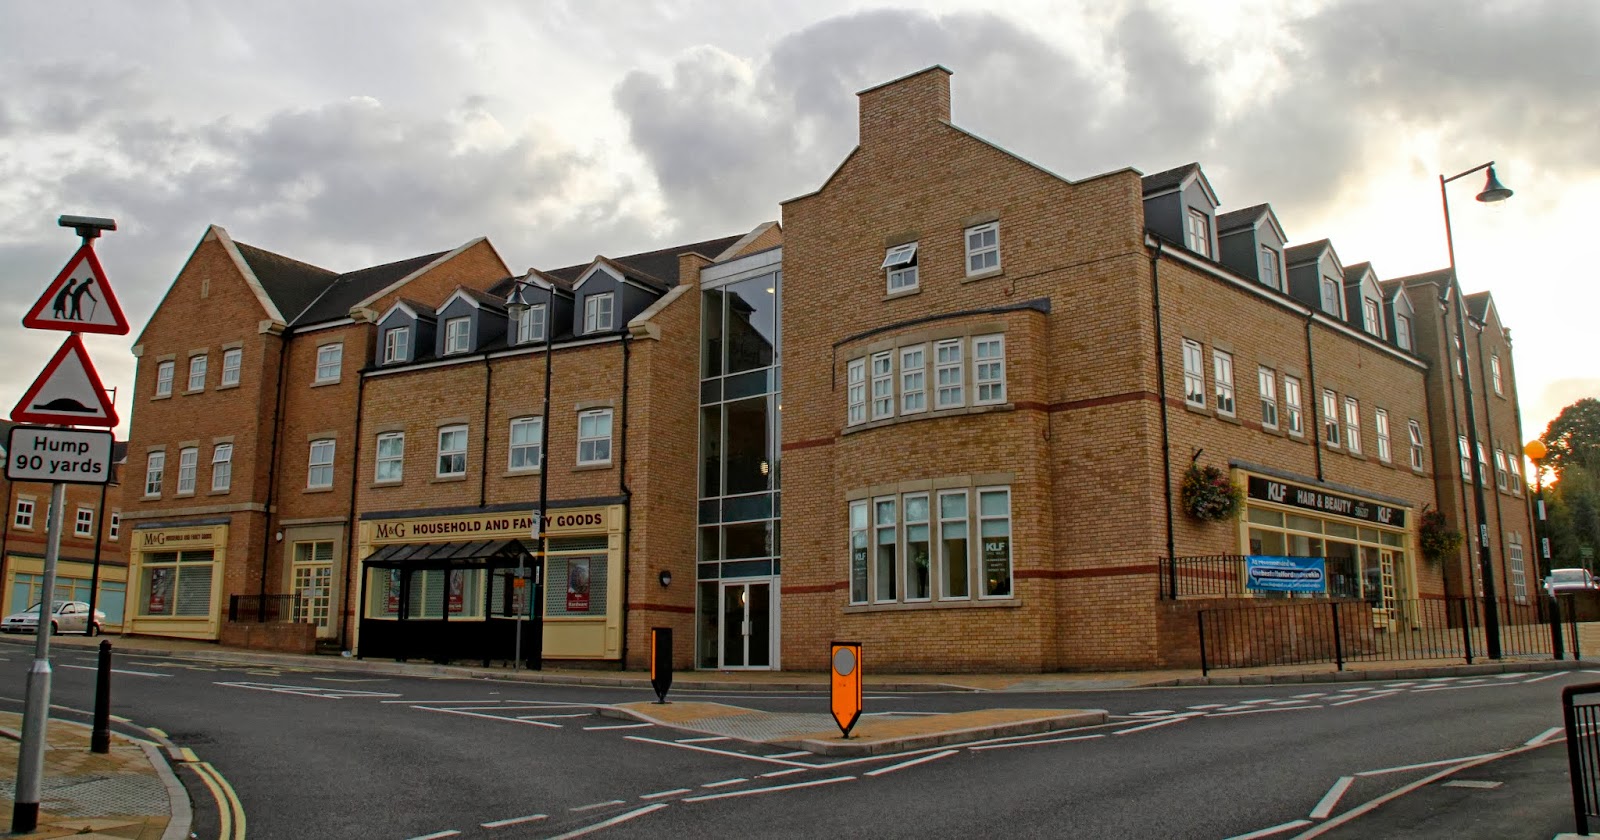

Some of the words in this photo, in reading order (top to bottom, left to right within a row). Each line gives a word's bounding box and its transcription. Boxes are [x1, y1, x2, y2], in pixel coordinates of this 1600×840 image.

[33, 436, 89, 455] Hump
[16, 455, 42, 470] 90
[49, 458, 102, 474] yards
[1267, 481, 1287, 502] KLF
[1297, 490, 1316, 507] HAIR
[1317, 494, 1323, 508] &
[1324, 495, 1351, 514] BEAUTY
[1377, 506, 1392, 523] KLF
[376, 523, 406, 539] M&G
[413, 521, 481, 535] HOUSEHOLD
[485, 520, 509, 531] AND
[513, 516, 552, 530] FANY
[557, 513, 602, 527] GOODS
[144, 532, 165, 546] M&G
[986, 542, 1005, 552] KLF
